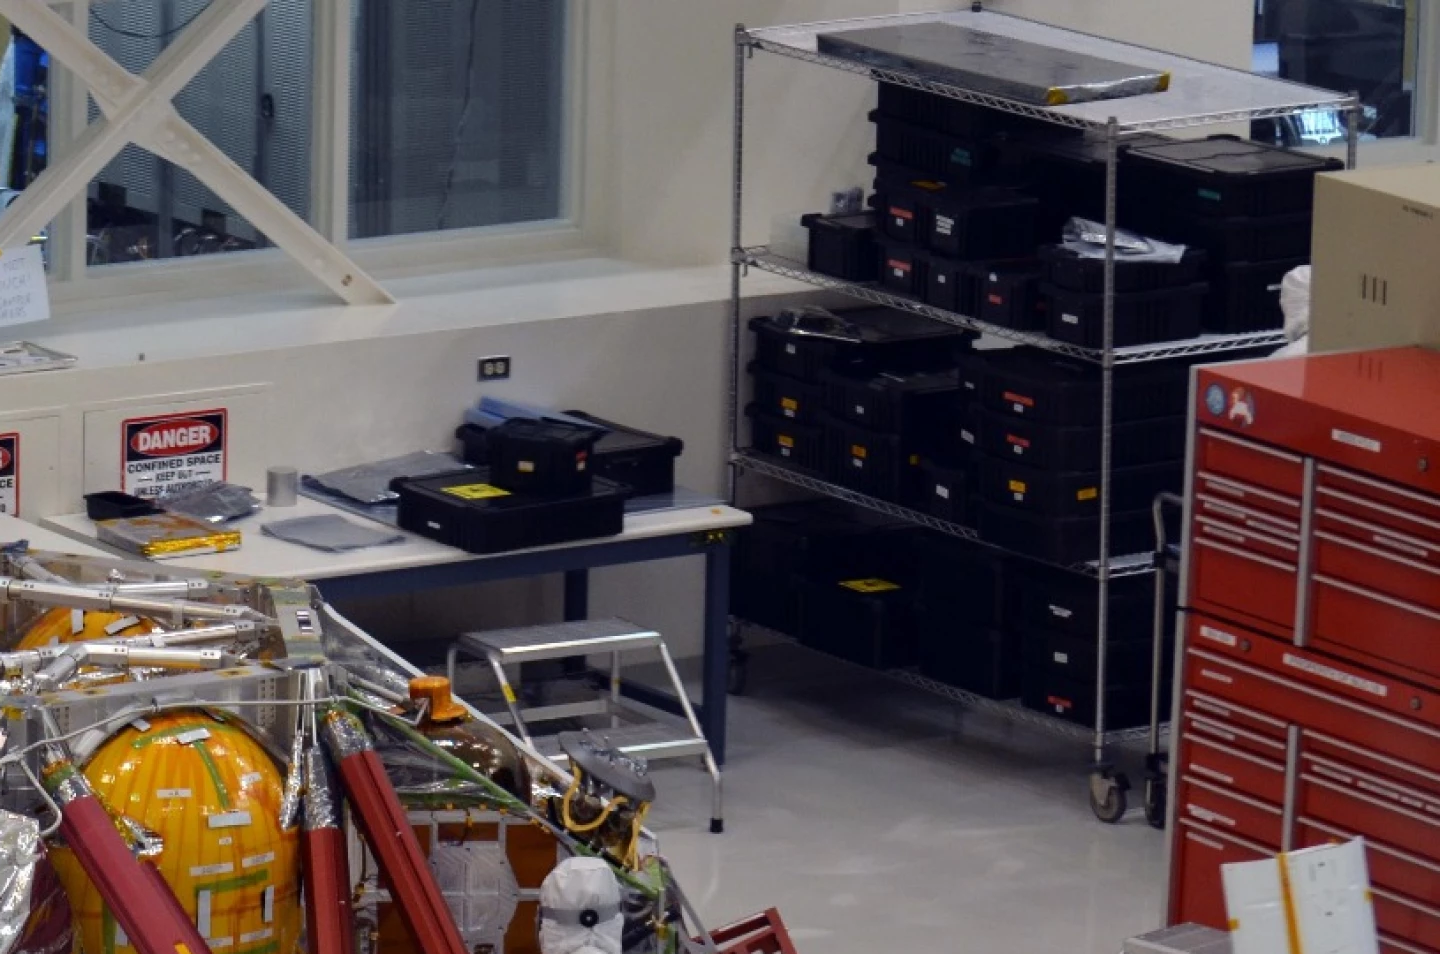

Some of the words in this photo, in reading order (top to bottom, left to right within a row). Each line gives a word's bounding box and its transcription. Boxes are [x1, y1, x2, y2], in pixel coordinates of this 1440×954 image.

[138, 425, 211, 452] DANGER
[126, 458, 183, 475] CONFINED
[186, 453, 221, 467] SPACE
[155, 471, 176, 483] KEEP
[177, 469, 193, 480] OUT
